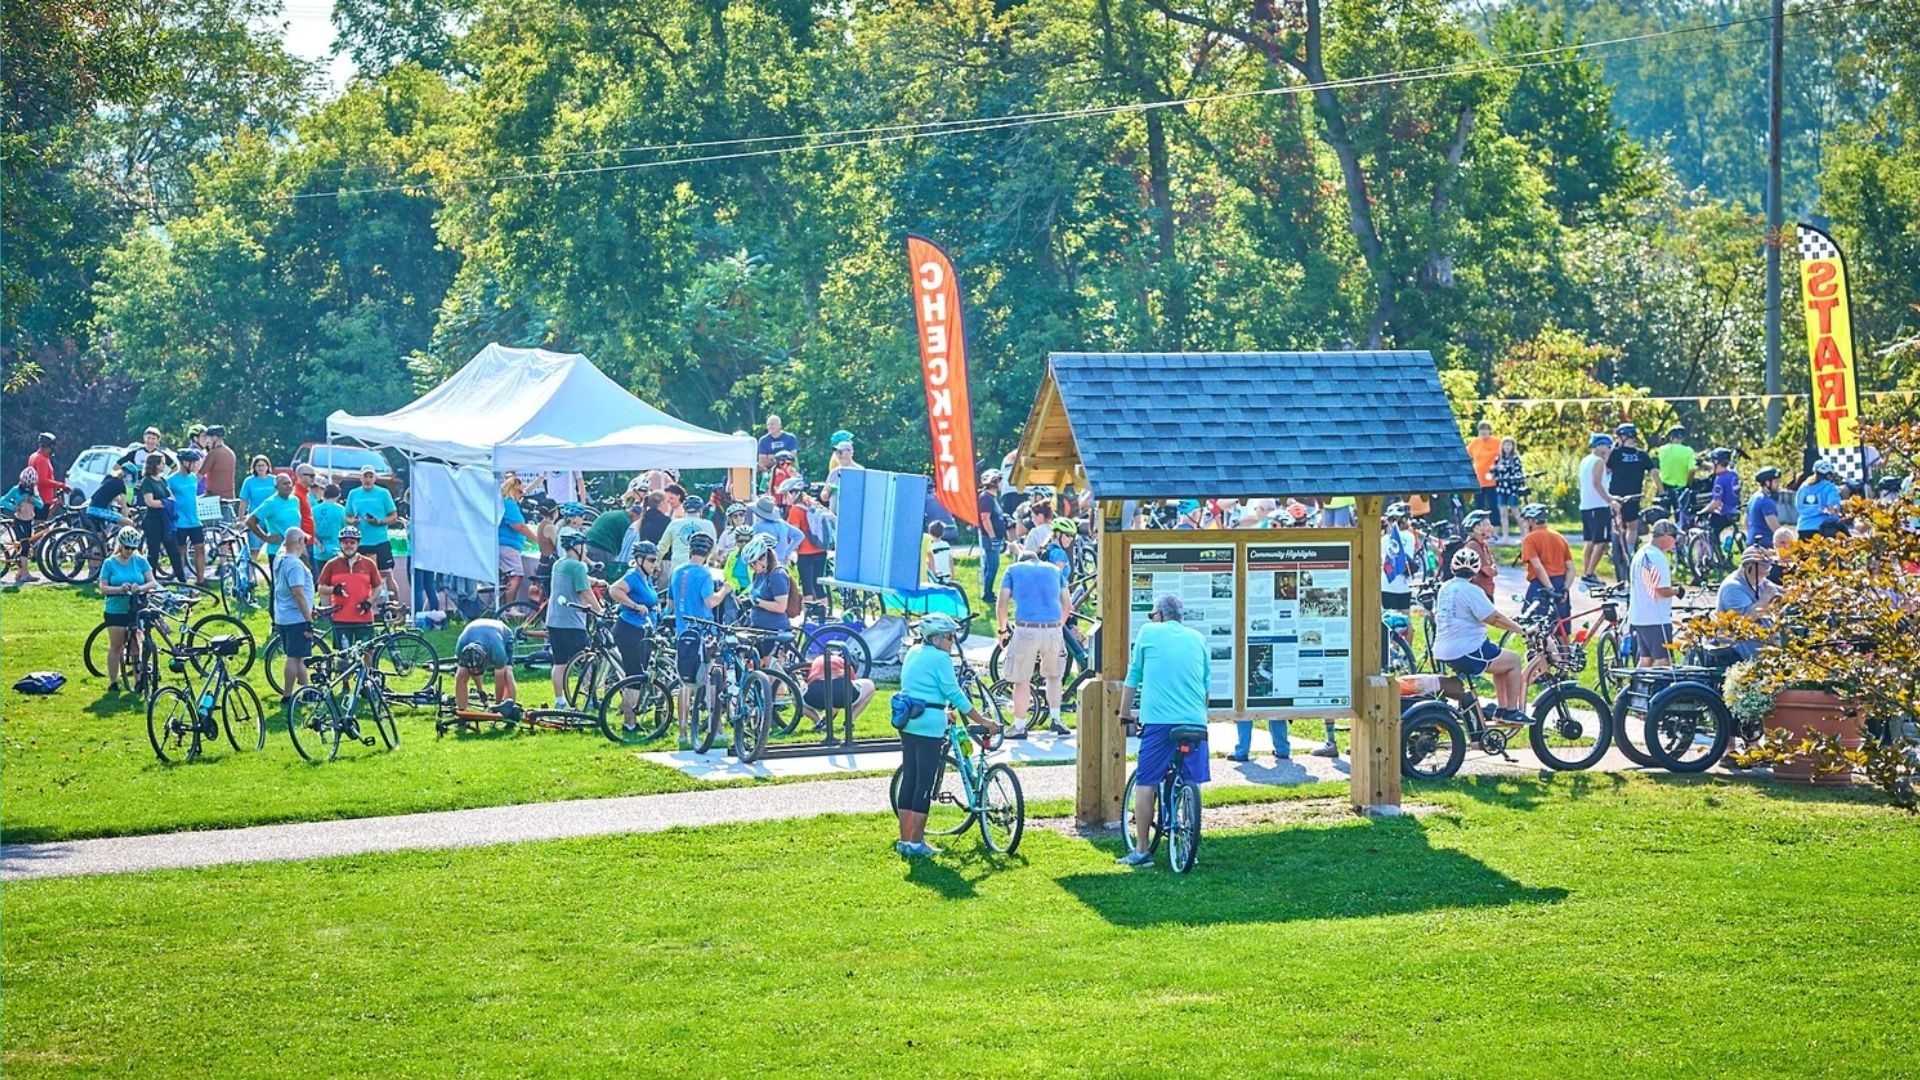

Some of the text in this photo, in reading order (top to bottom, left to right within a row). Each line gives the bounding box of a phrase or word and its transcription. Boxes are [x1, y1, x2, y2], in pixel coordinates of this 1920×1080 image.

[1133, 550, 1168, 560] Wheatland
[1250, 549, 1317, 560] Community Highlights
